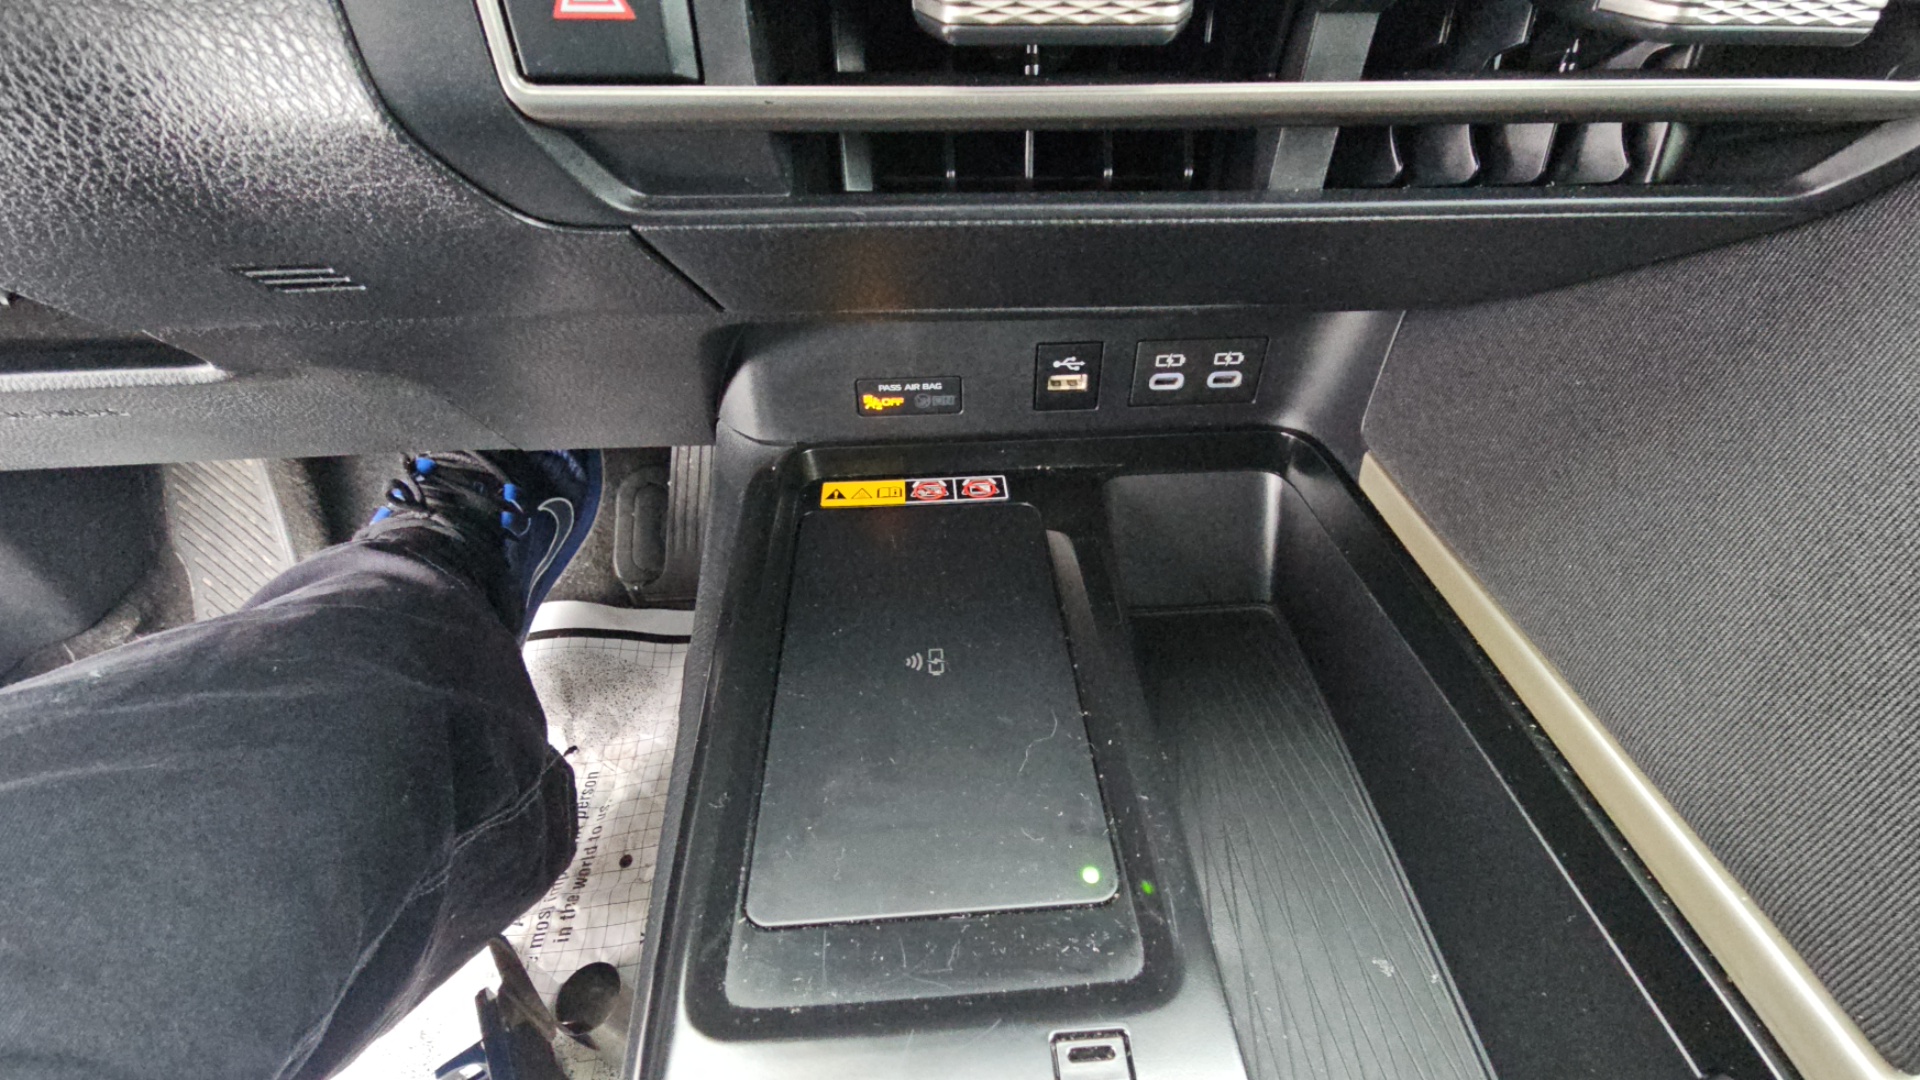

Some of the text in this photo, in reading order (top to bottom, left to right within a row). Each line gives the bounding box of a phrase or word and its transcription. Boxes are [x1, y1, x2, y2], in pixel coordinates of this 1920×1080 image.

[878, 382, 942, 392] PASS AIR BAG
[881, 397, 904, 407] OFF
[577, 771, 600, 819] person
[588, 825, 603, 842] to
[573, 844, 598, 890] world
[560, 894, 580, 920] the
[553, 926, 573, 943] in
